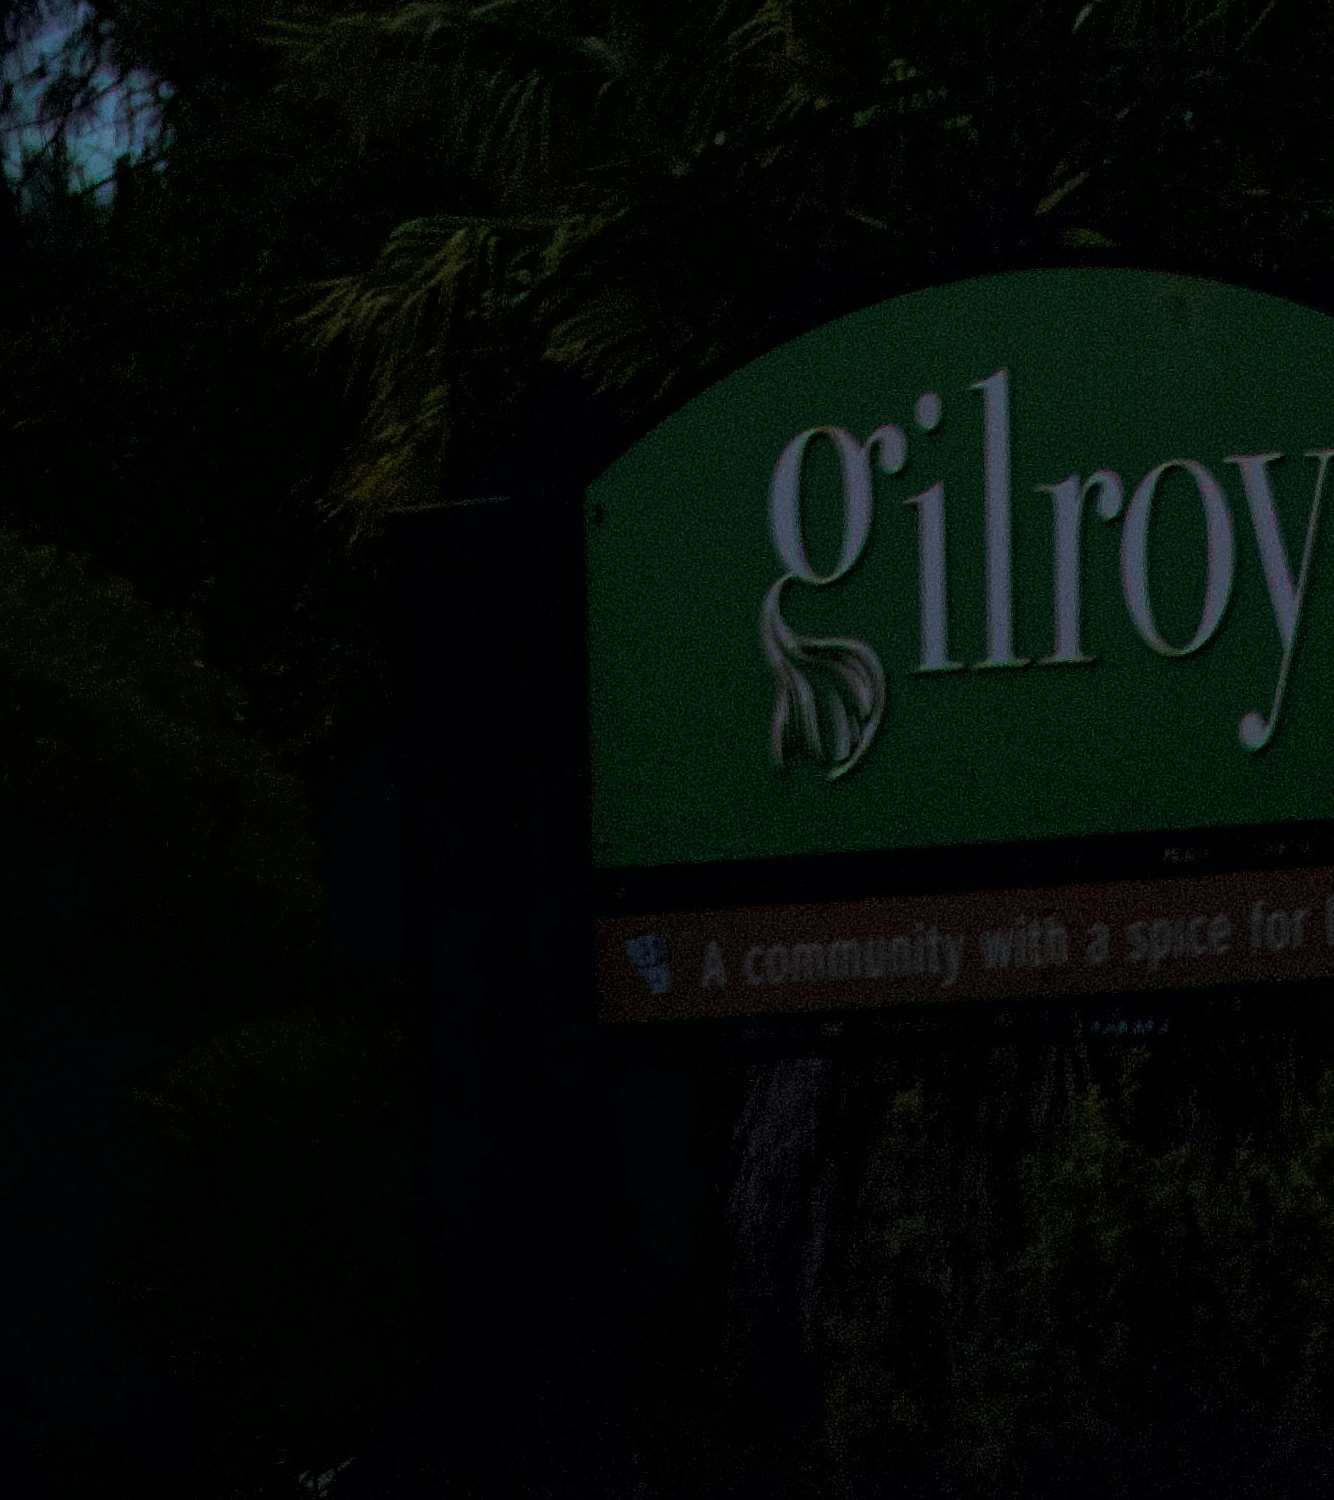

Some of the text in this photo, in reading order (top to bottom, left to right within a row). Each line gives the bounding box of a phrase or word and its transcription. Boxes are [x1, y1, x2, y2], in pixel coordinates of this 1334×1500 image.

[701, 938, 728, 989] A
[745, 923, 966, 987] community
[979, 914, 1068, 970] with
[1085, 922, 1112, 965] a
[1123, 911, 1234, 972] spice
[1248, 899, 1309, 954] for
